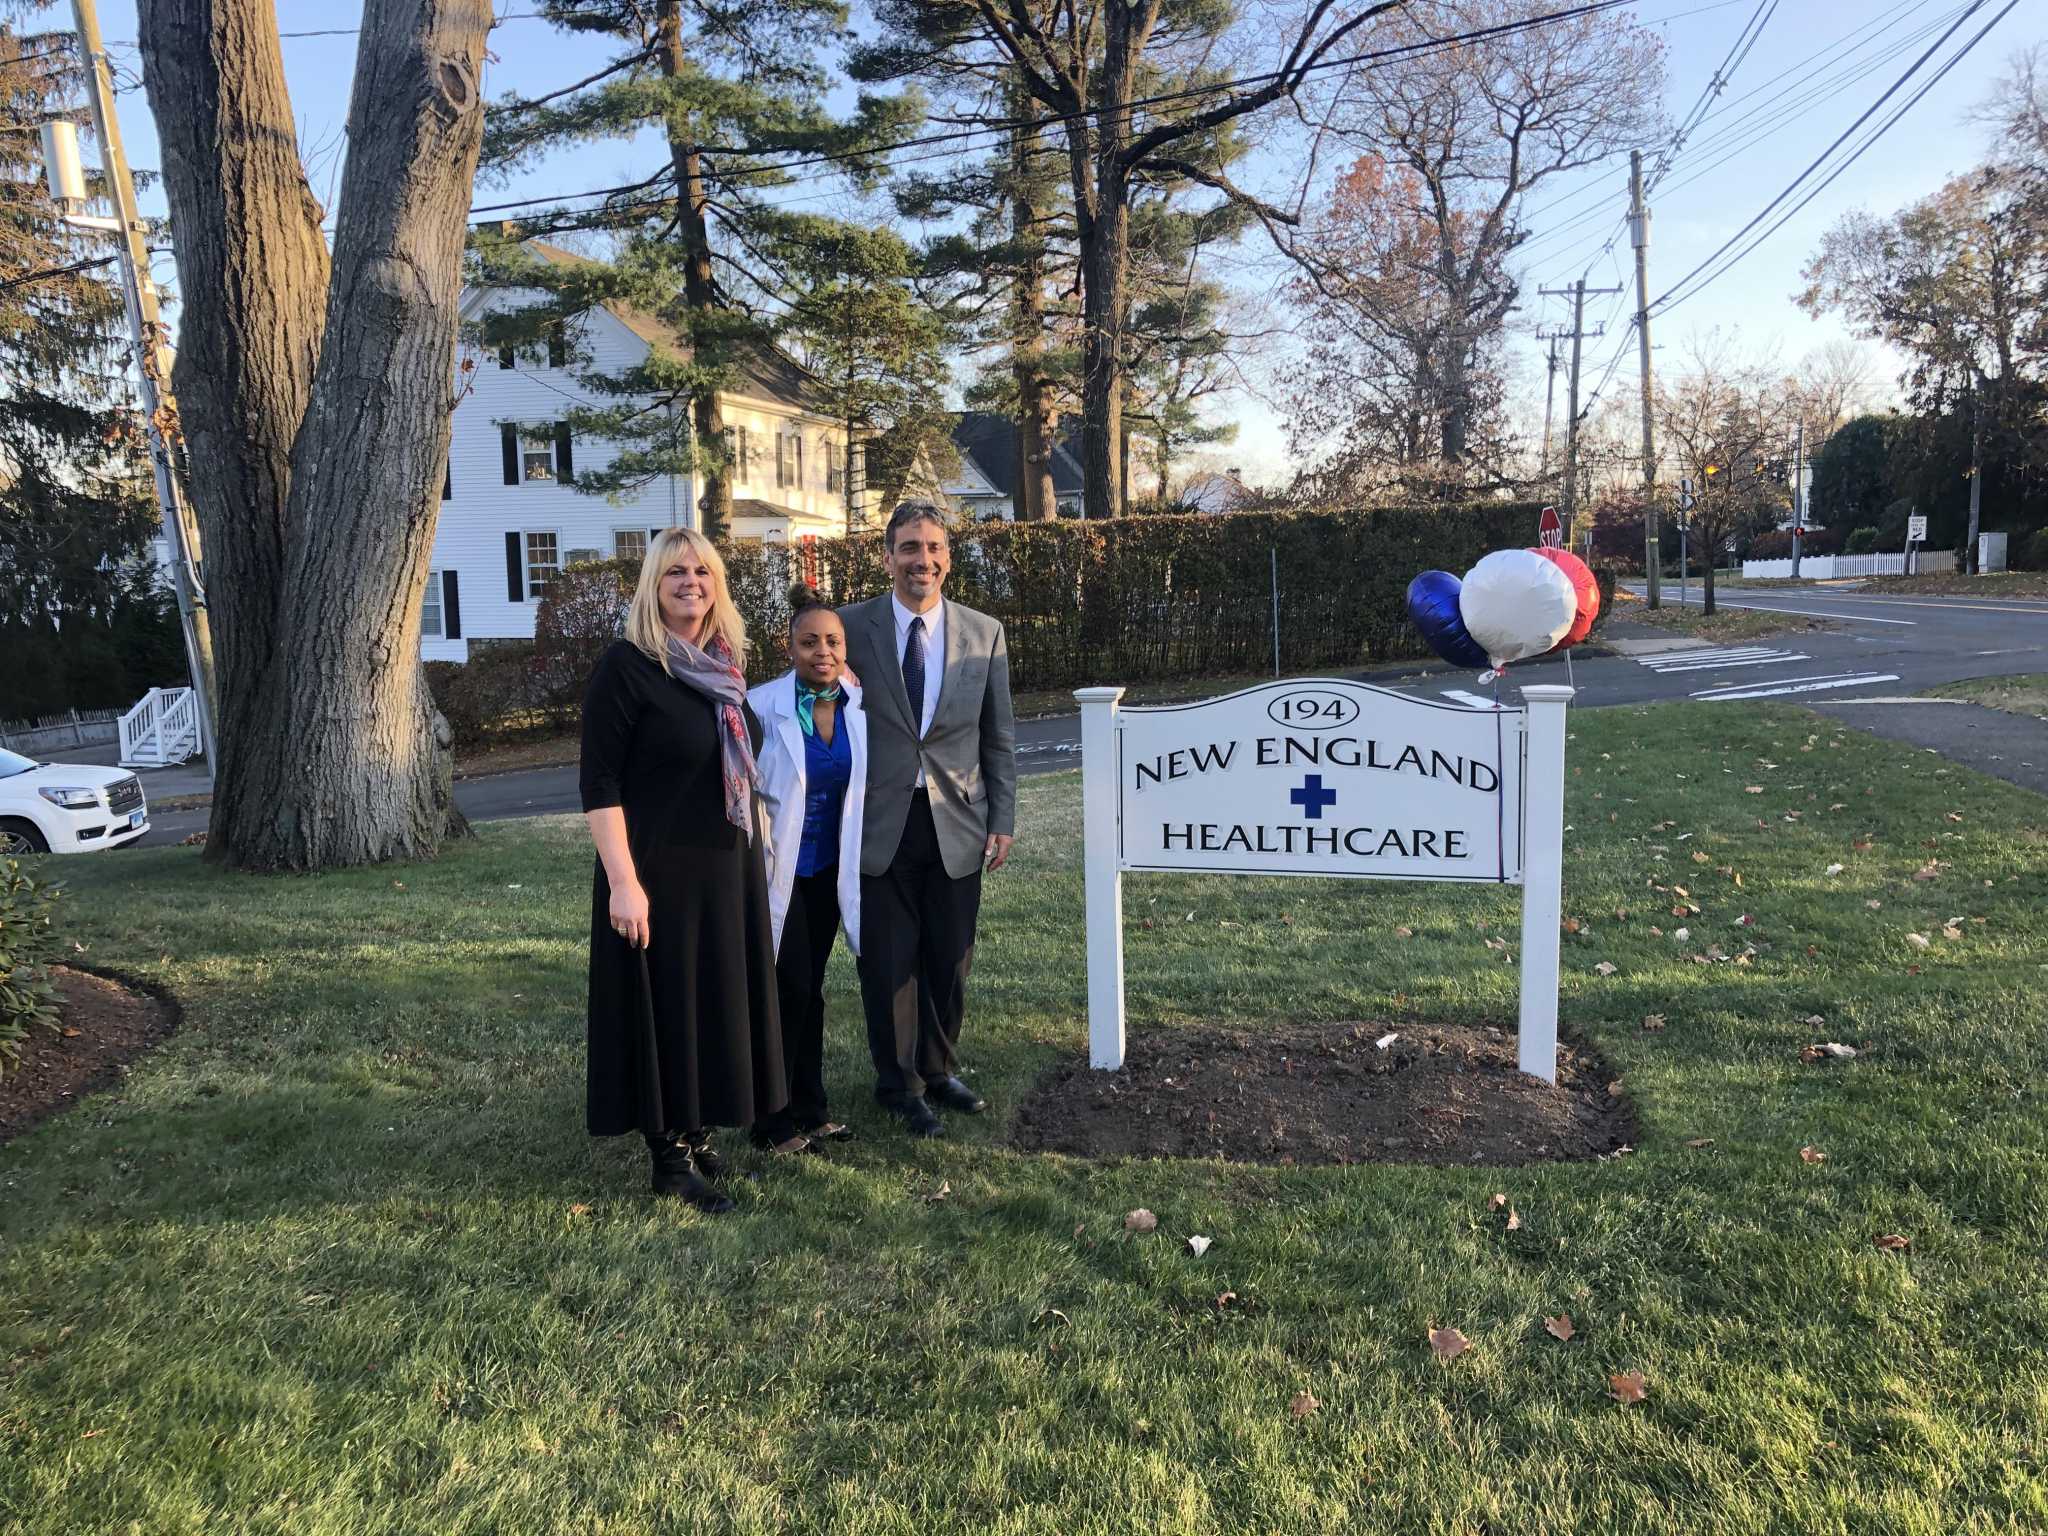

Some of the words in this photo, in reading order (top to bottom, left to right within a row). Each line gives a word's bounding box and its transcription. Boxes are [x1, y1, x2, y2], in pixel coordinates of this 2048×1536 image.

[1540, 528, 1561, 549] STOP
[1281, 699, 1346, 720] 194
[1135, 741, 1237, 790] NEW
[1256, 737, 1499, 793] ENGLAND
[1162, 823, 1468, 858] HEALTHCARE
